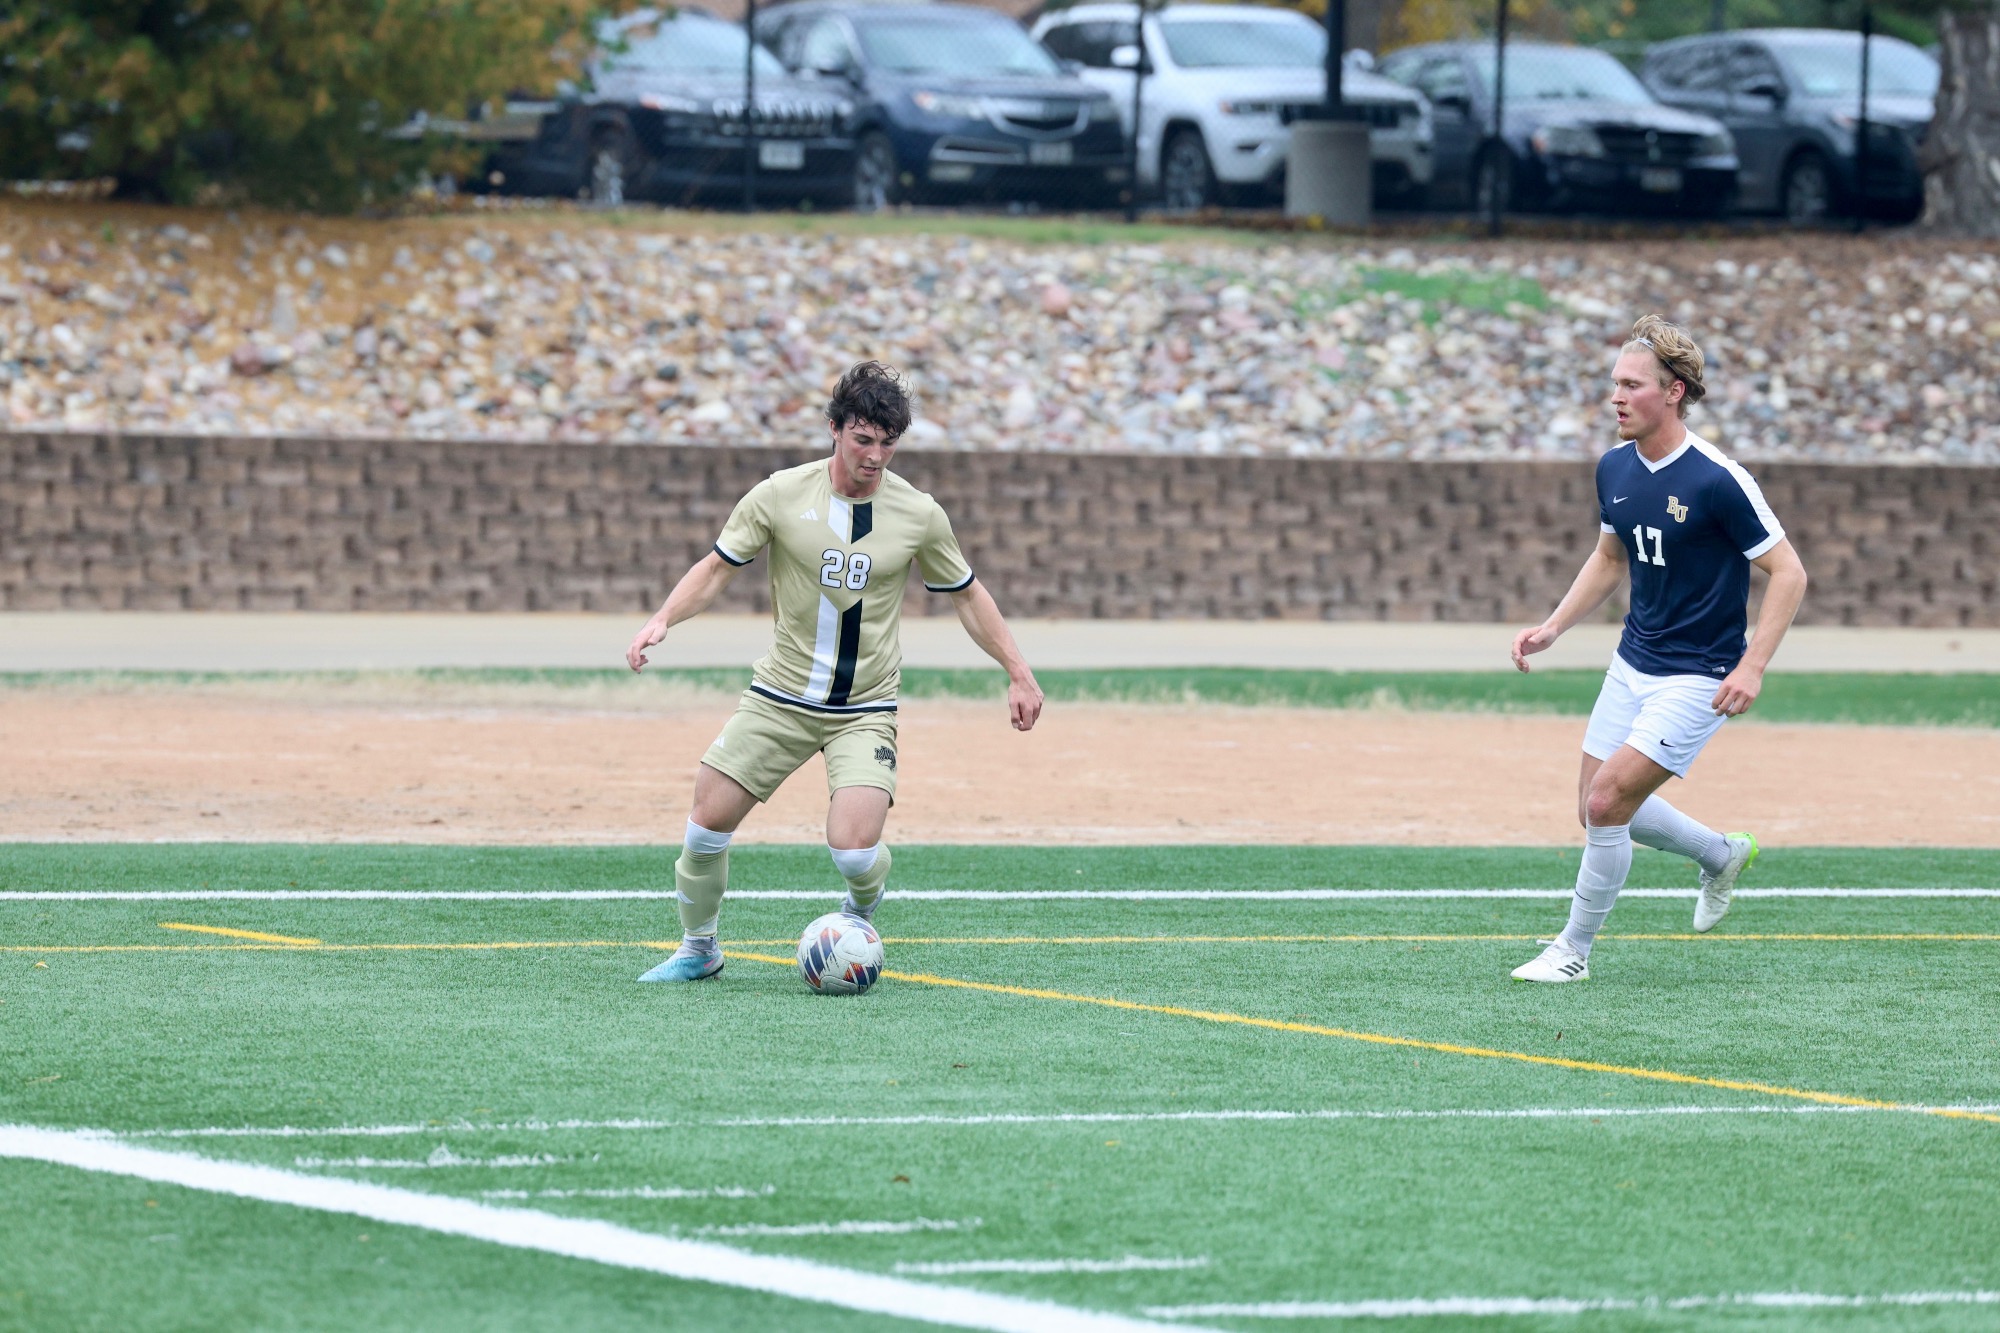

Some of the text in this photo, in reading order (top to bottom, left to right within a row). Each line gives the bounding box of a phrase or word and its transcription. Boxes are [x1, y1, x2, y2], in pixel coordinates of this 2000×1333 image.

[1666, 495, 1688, 523] BU
[1632, 524, 1666, 566] 17
[820, 548, 872, 590] 28
